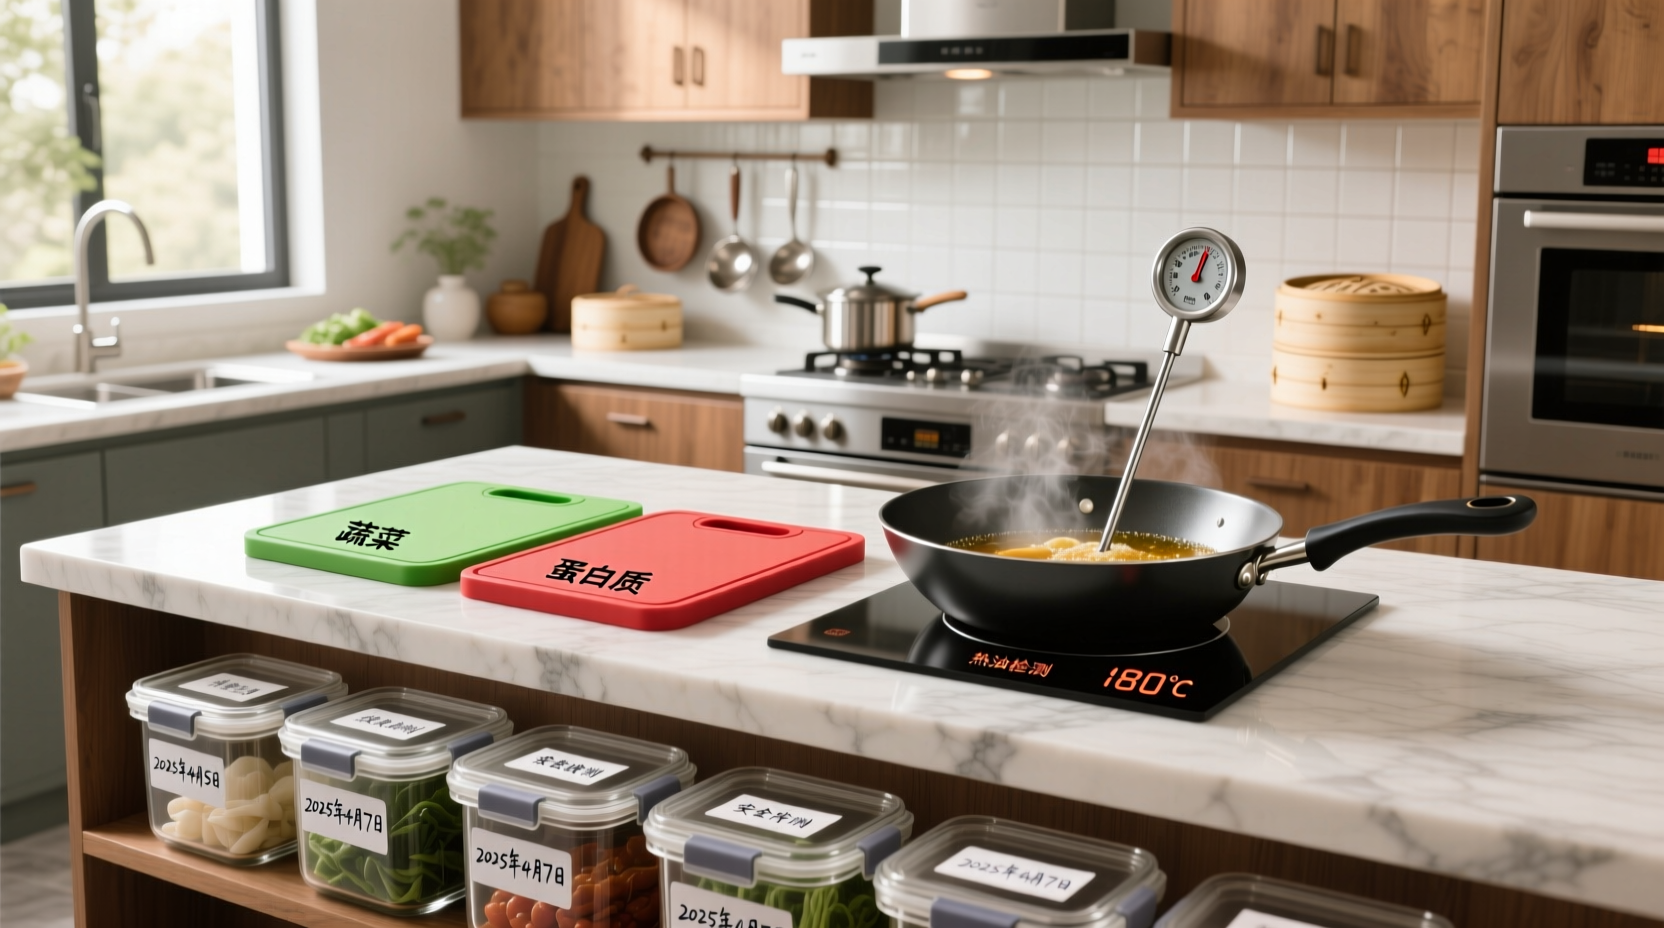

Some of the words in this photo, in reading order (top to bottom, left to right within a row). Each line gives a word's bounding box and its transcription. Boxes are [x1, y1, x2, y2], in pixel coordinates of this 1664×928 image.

[335, 520, 411, 551] 蔬菜
[546, 558, 653, 595] 蛋白质
[153, 756, 220, 789] 2025年4月5日
[304, 797, 382, 834] 2025年4月7日
[475, 847, 565, 887] 2025年4月7日
[958, 858, 1071, 891] 2025年4月7日
